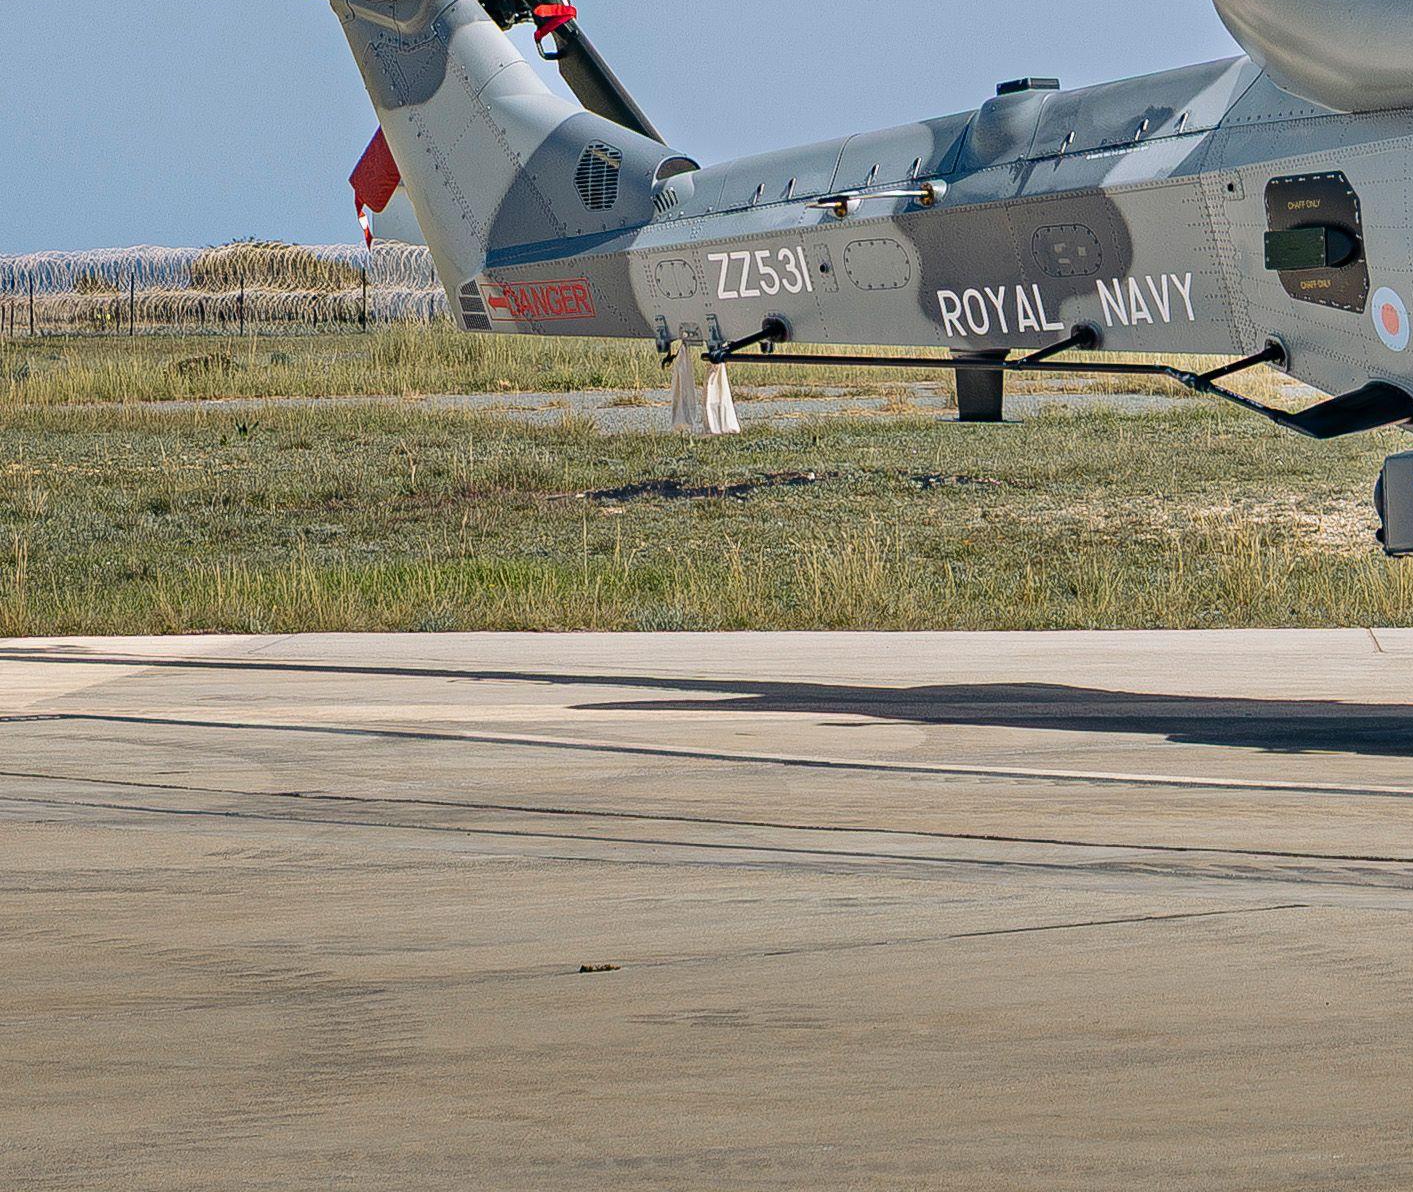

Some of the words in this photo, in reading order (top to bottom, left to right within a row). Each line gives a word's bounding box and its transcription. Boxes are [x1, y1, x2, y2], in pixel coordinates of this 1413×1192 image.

[1305, 198, 1321, 209] ONLY
[707, 246, 813, 300] ZZ531
[503, 283, 592, 316] DANGER
[936, 283, 1065, 338] ROYAL
[1095, 271, 1196, 327] NAVY
